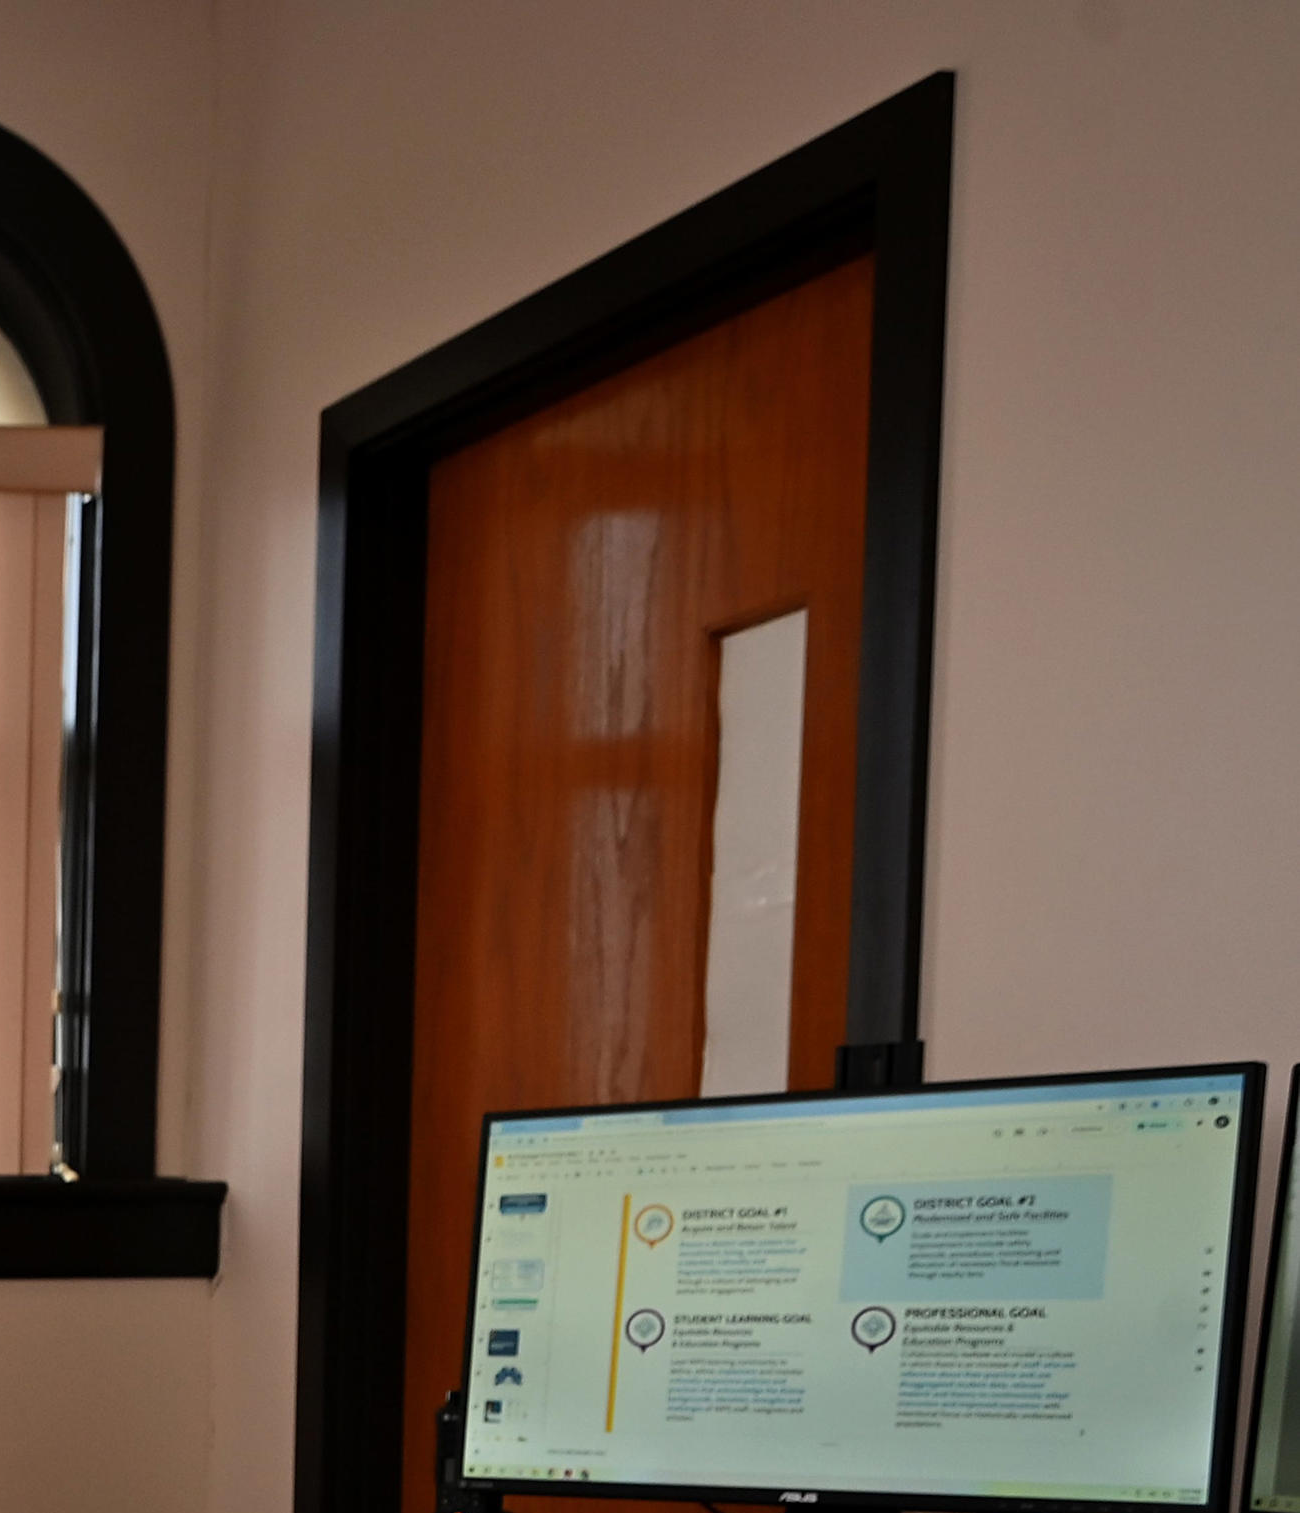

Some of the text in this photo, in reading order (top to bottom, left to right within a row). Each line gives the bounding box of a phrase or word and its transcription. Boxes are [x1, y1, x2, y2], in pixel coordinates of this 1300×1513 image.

[913, 1197, 974, 1210] DISTRICT
[976, 1197, 1012, 1207] GOAL
[682, 1206, 788, 1220] DISTRICT GOAL #1
[976, 1211, 993, 1221] and
[998, 1210, 1021, 1221] Safe
[1023, 1210, 1069, 1221] Facilities
[716, 1223, 734, 1232] and
[769, 1222, 798, 1231] Talent
[673, 1313, 812, 1324] STUDENT LEARNING GOAL
[904, 1307, 1046, 1319] PROFESSIONAL GOAL
[903, 1324, 951, 1333] Equitable
[953, 1323, 1003, 1333] Resources
[902, 1337, 1005, 1348] Education Programs
[778, 1491, 818, 1503] ASUS
